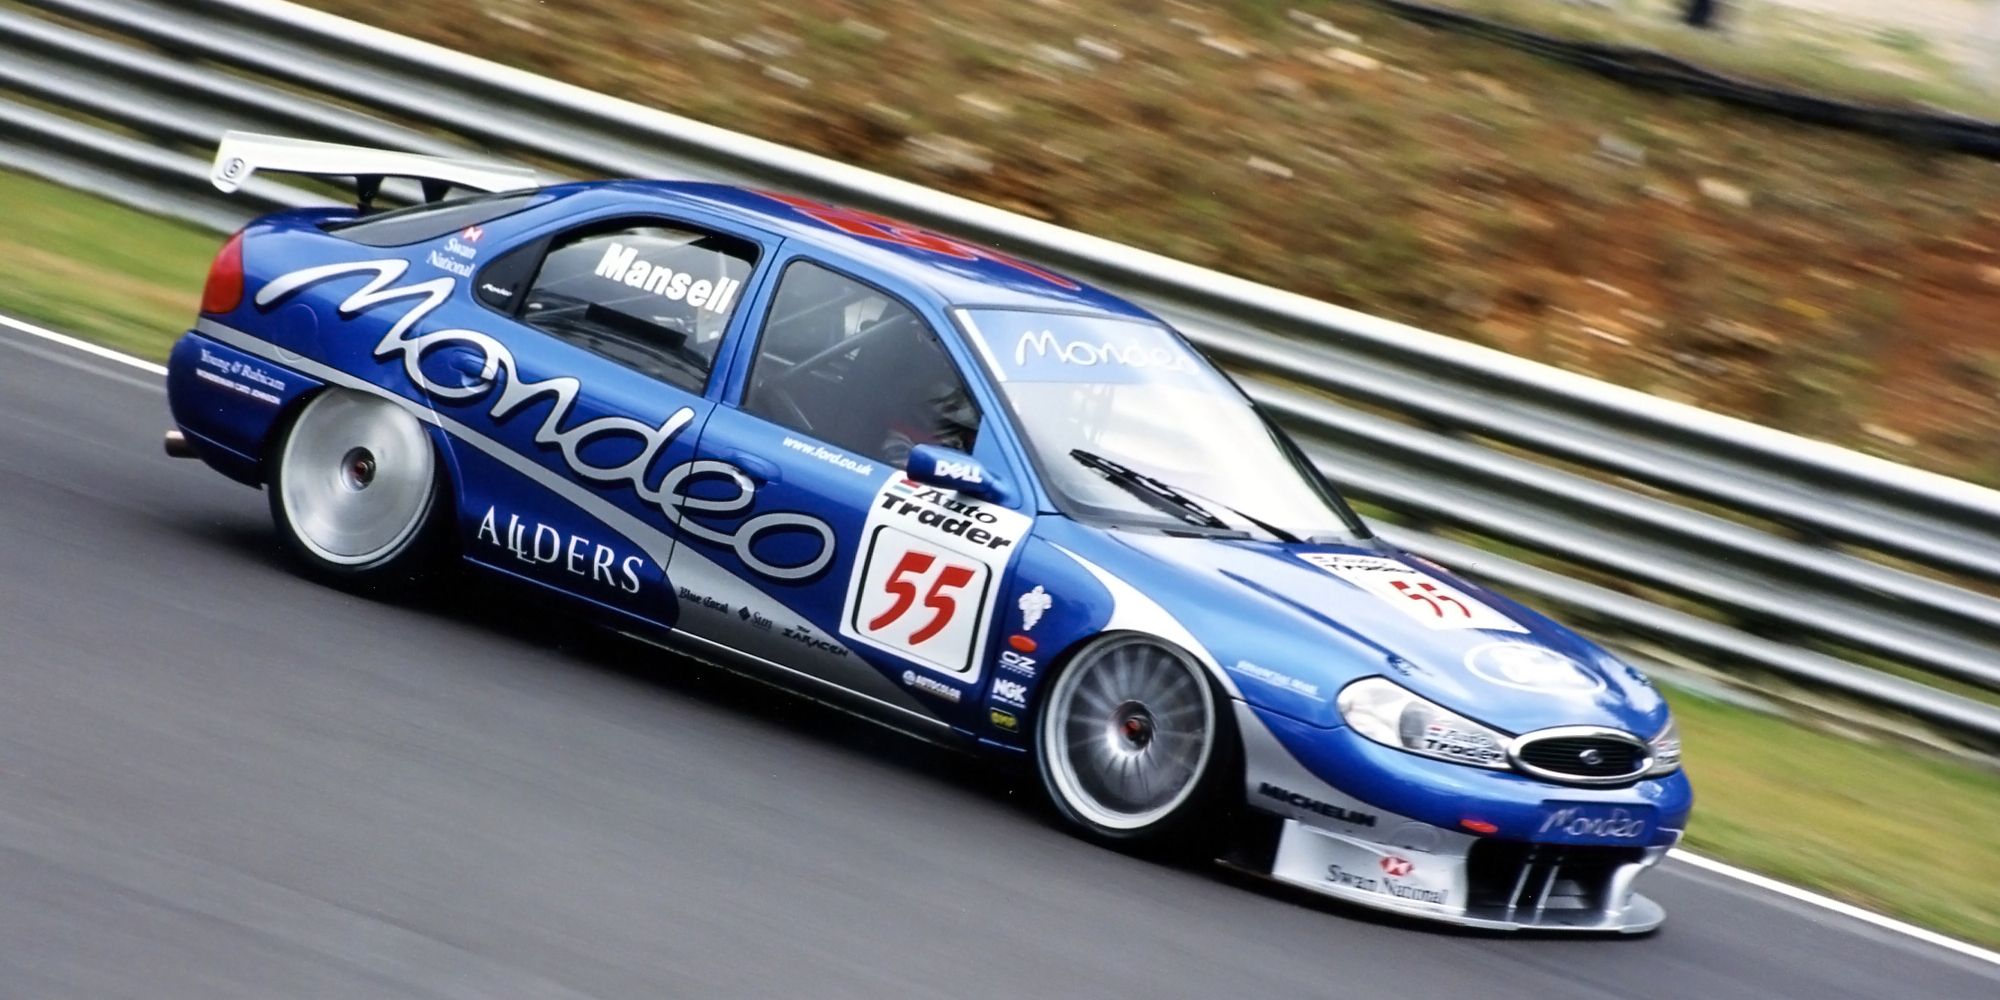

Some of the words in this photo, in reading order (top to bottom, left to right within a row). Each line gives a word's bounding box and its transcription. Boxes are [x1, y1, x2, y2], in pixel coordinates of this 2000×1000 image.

[426, 250, 476, 278] National
[444, 238, 477, 259] Swan
[595, 242, 740, 315] Mansell
[255, 257, 836, 579] Mondeo
[783, 436, 874, 476] www.ford.co.uk
[881, 492, 1012, 550] Trader
[913, 488, 998, 524] Auto
[477, 505, 643, 594] ALLDERS
[679, 586, 702, 604] Blue
[868, 551, 976, 646] 55
[1389, 580, 1472, 619] 55
[753, 611, 773, 630] Sun
[1001, 650, 1037, 671] OZ
[992, 677, 1027, 704] NGK
[1258, 782, 1377, 827] MICHELIN
[1538, 807, 1645, 837] Mondeo
[1325, 864, 1378, 892] Swan
[1382, 877, 1448, 905] National
